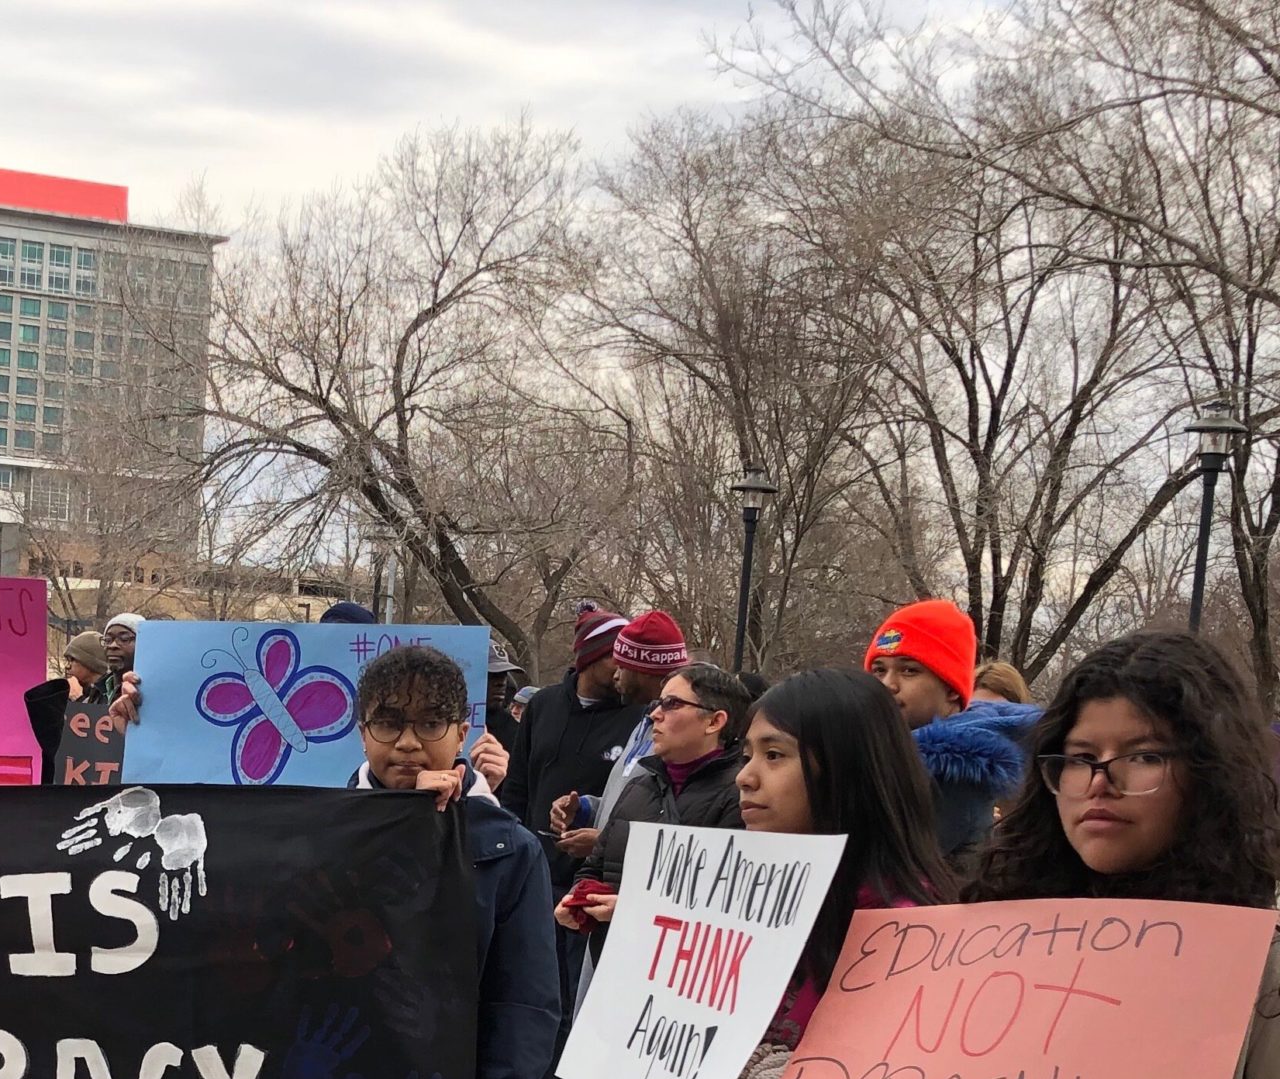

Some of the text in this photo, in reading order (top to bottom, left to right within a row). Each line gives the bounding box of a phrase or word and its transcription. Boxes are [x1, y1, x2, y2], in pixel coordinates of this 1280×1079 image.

[640, 649, 681, 664] Kappa
[0, 869, 159, 977] IS
[646, 828, 812, 929] Make America
[653, 915, 753, 1015] THINK
